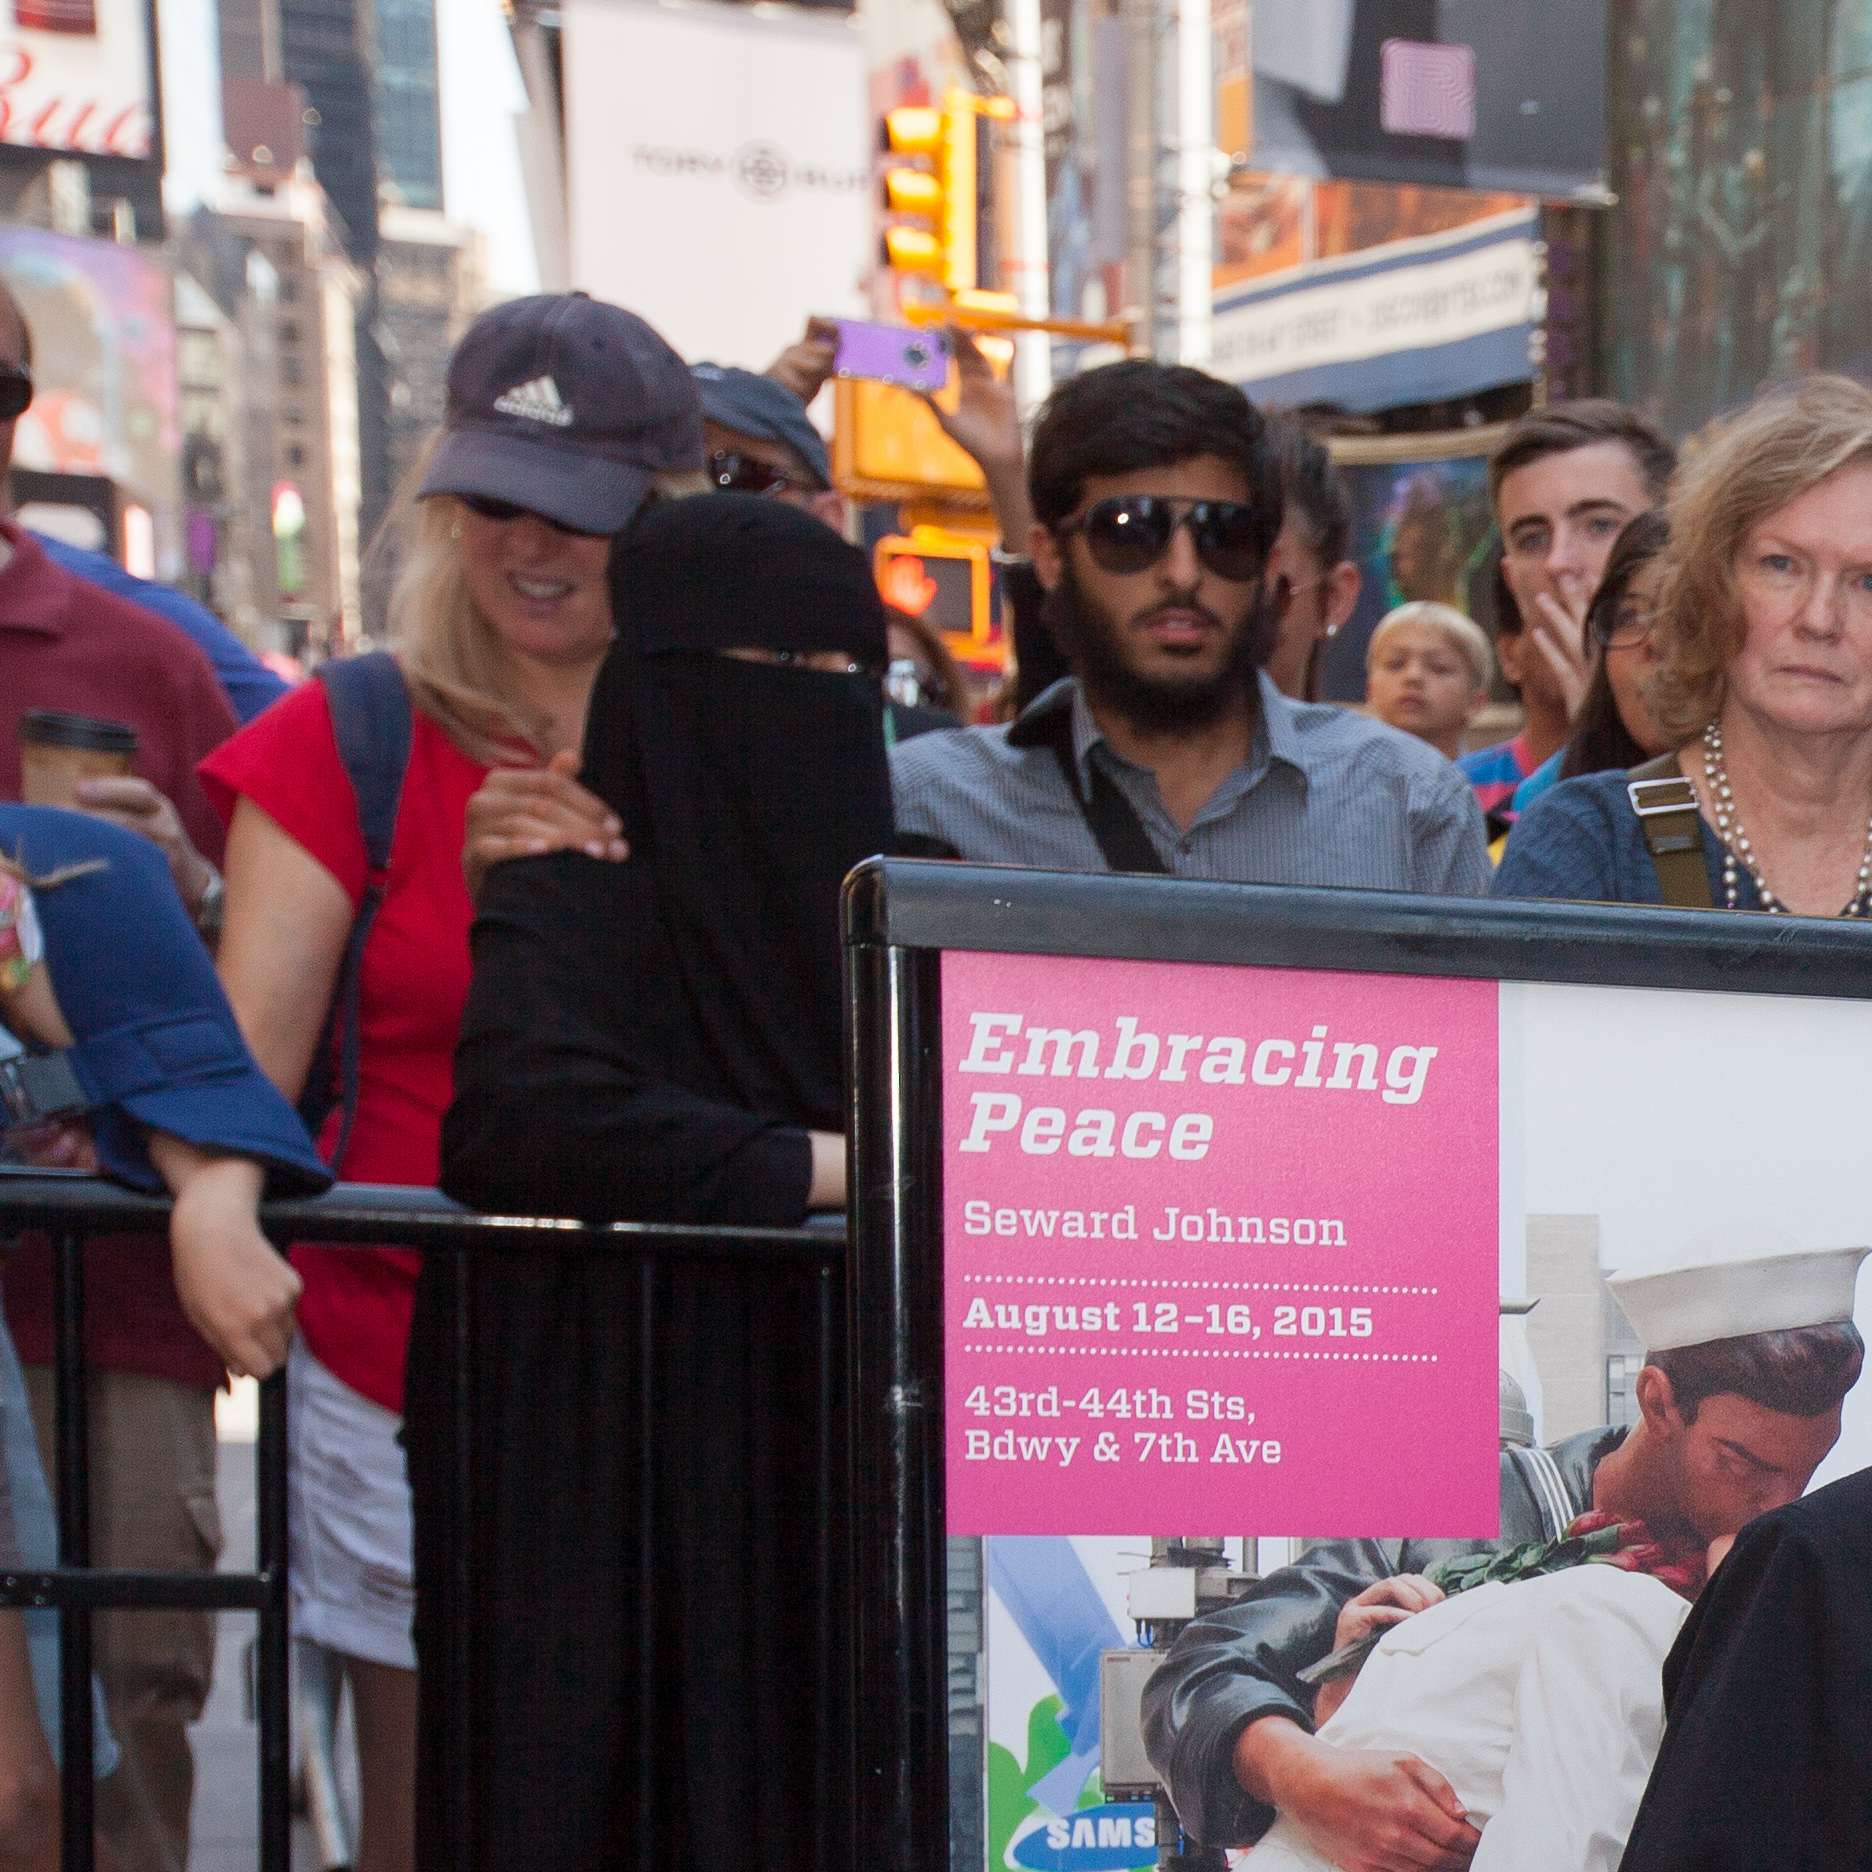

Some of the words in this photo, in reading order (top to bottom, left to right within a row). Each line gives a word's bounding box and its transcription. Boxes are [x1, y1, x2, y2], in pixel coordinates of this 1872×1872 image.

[958, 1011, 1437, 1105] Embracing
[958, 1091, 1214, 1161] Peace
[963, 1200, 1138, 1239] Seward
[1152, 1206, 1348, 1247] Johnson
[963, 1297, 1121, 1334] August
[1273, 1306, 1373, 1338] 2015
[964, 1385, 1174, 1420] 43rd-44th
[1186, 1389, 1256, 1427] Sts,
[964, 1428, 1080, 1468] Bdwy
[1092, 1433, 1121, 1462] &
[1133, 1432, 1200, 1463] 7th
[1210, 1433, 1282, 1464] Ave
[1046, 1817, 1156, 1849] SAMS
